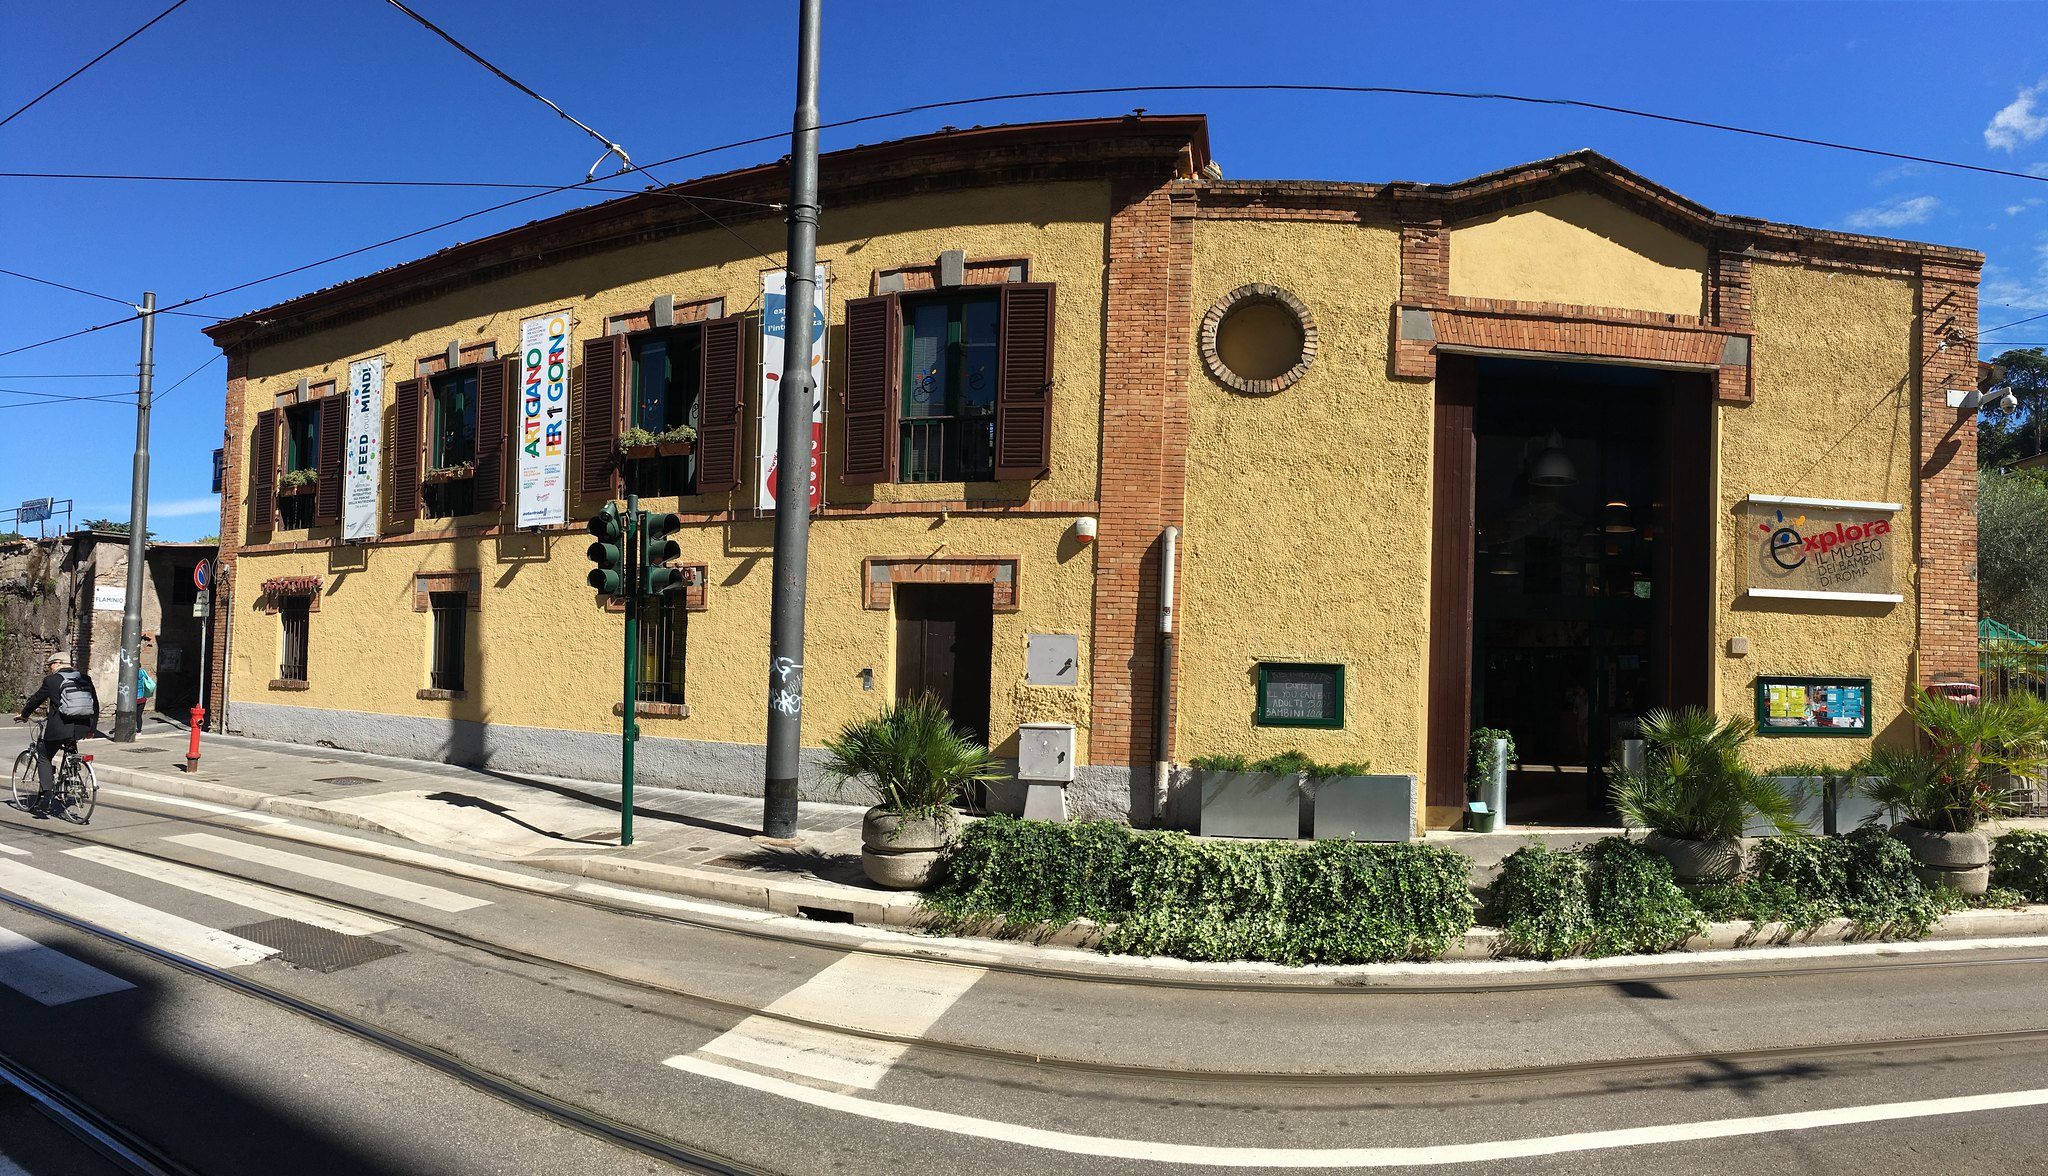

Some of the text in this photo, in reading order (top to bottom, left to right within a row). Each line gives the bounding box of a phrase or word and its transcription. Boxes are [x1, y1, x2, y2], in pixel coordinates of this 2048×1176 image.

[547, 317, 566, 402] GIORNO
[361, 368, 372, 413] MIND!
[525, 348, 542, 457] ARTIGIANO
[546, 420, 562, 456] PER
[358, 434, 368, 475] FEED
[1770, 519, 1890, 569] explora
[1815, 538, 1882, 565] IL MUSEO
[1817, 551, 1886, 576] DEI BAMBINI
[1820, 568, 1869, 587] DI ROMA
[95, 596, 124, 604] FLAMINIO
[1273, 699, 1303, 708] ADULTI
[1282, 690, 1297, 698] YOU
[1300, 690, 1315, 699] CAN
[1265, 707, 1305, 717] BAMBINI
